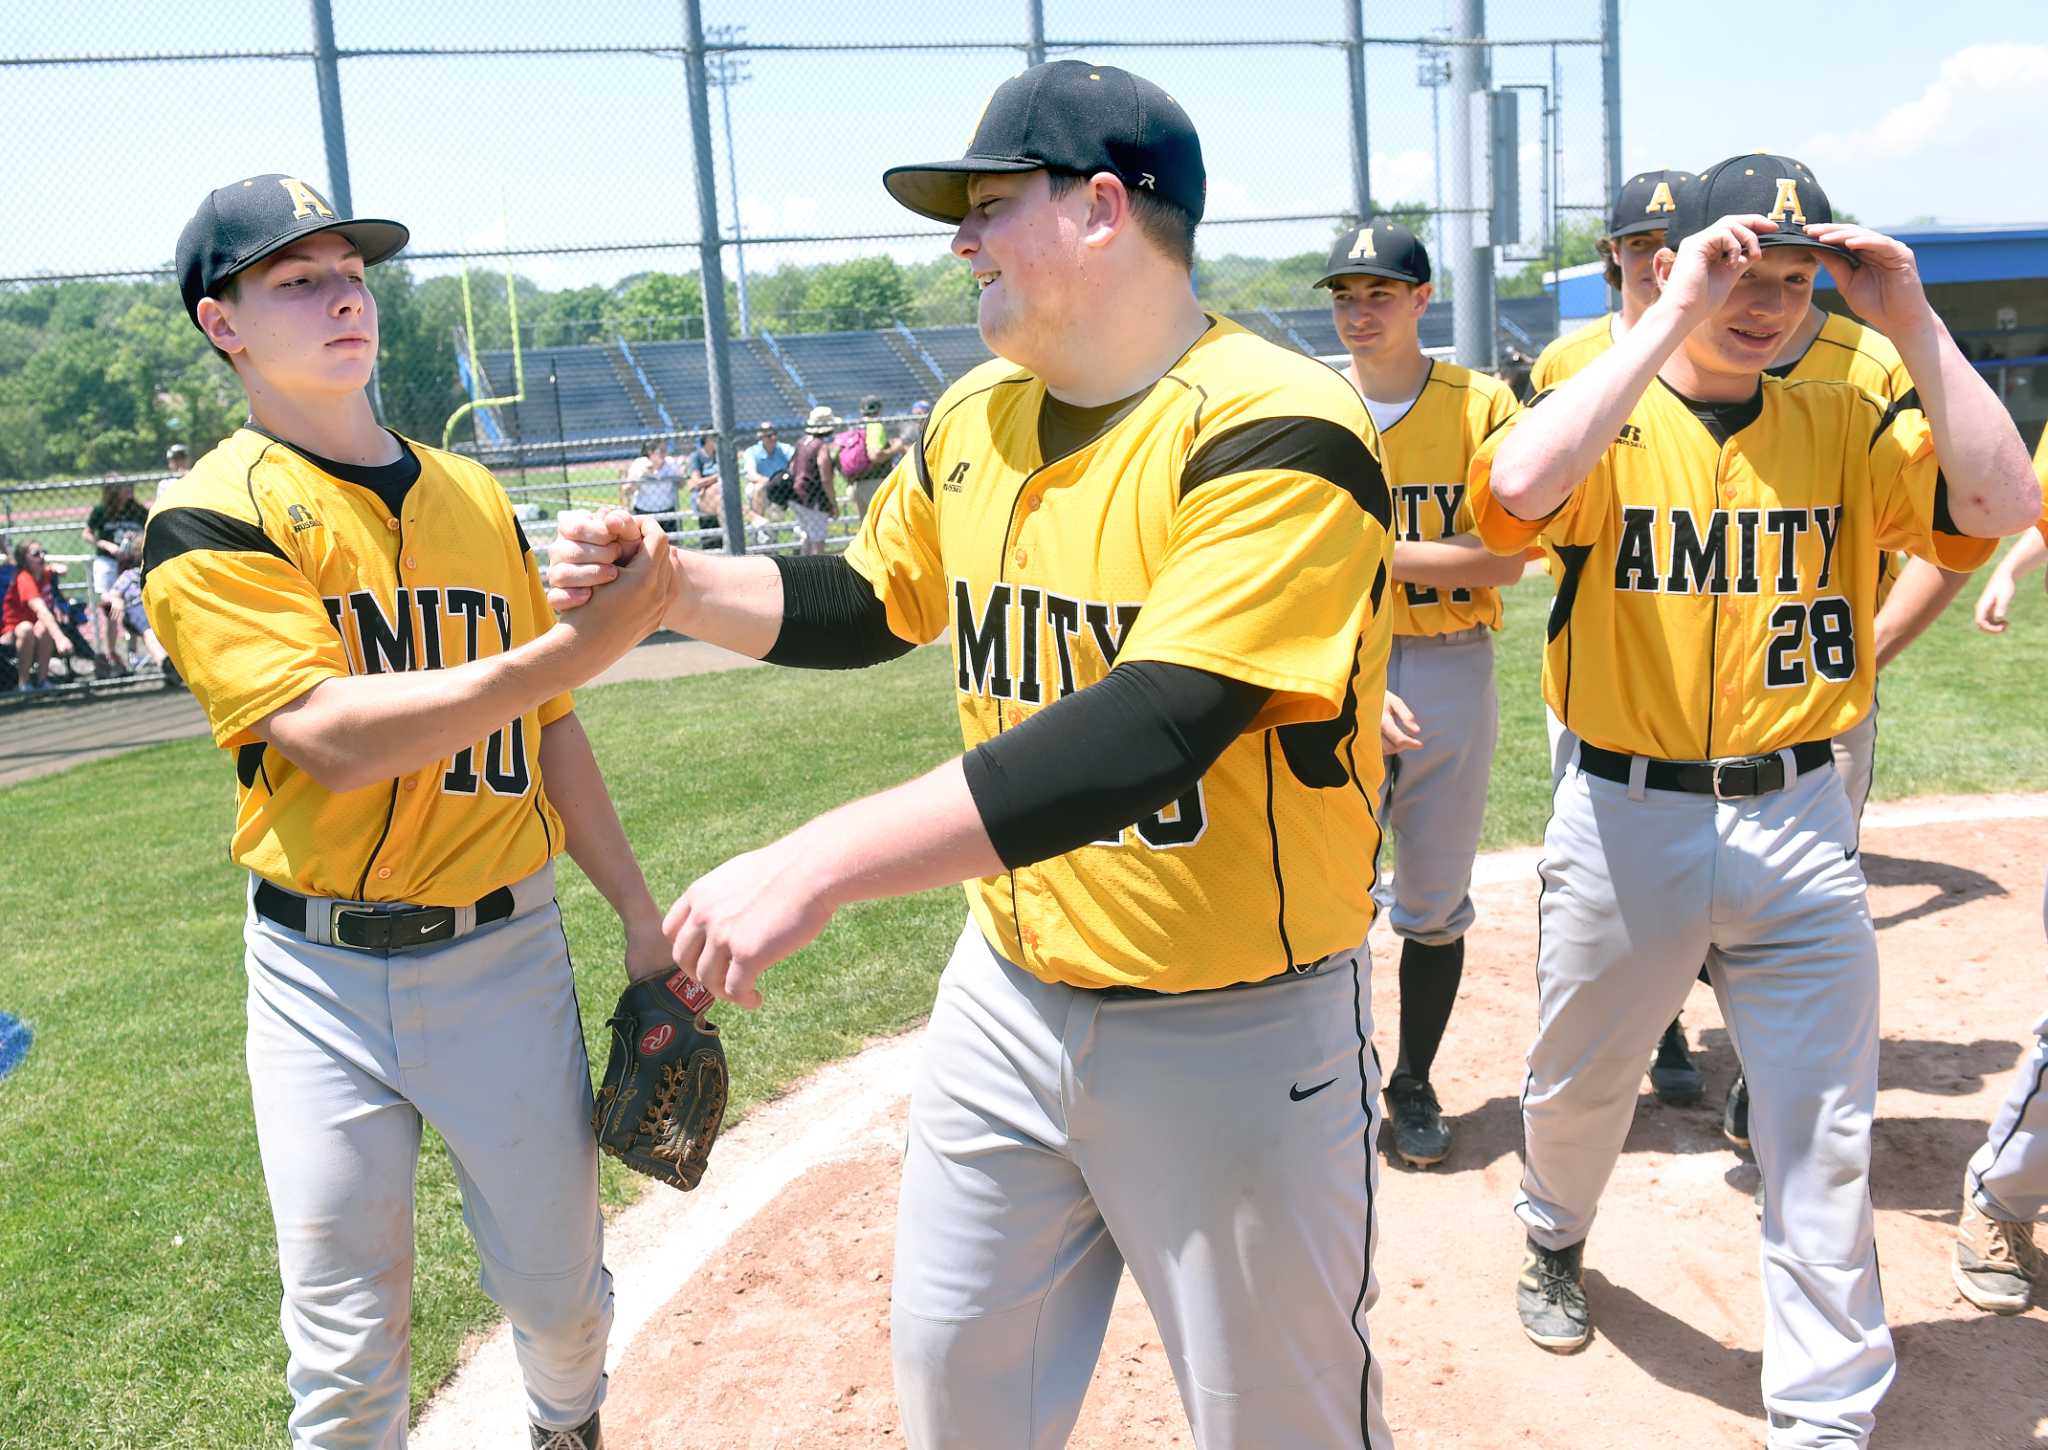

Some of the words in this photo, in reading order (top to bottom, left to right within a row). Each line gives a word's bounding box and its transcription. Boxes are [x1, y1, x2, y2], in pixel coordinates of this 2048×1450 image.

[279, 179, 336, 220] A
[1645, 182, 1676, 213] A
[1767, 178, 1807, 226] A
[1348, 228, 1377, 259] A
[1614, 503, 1842, 596] AMITY
[1764, 595, 1857, 690] 28
